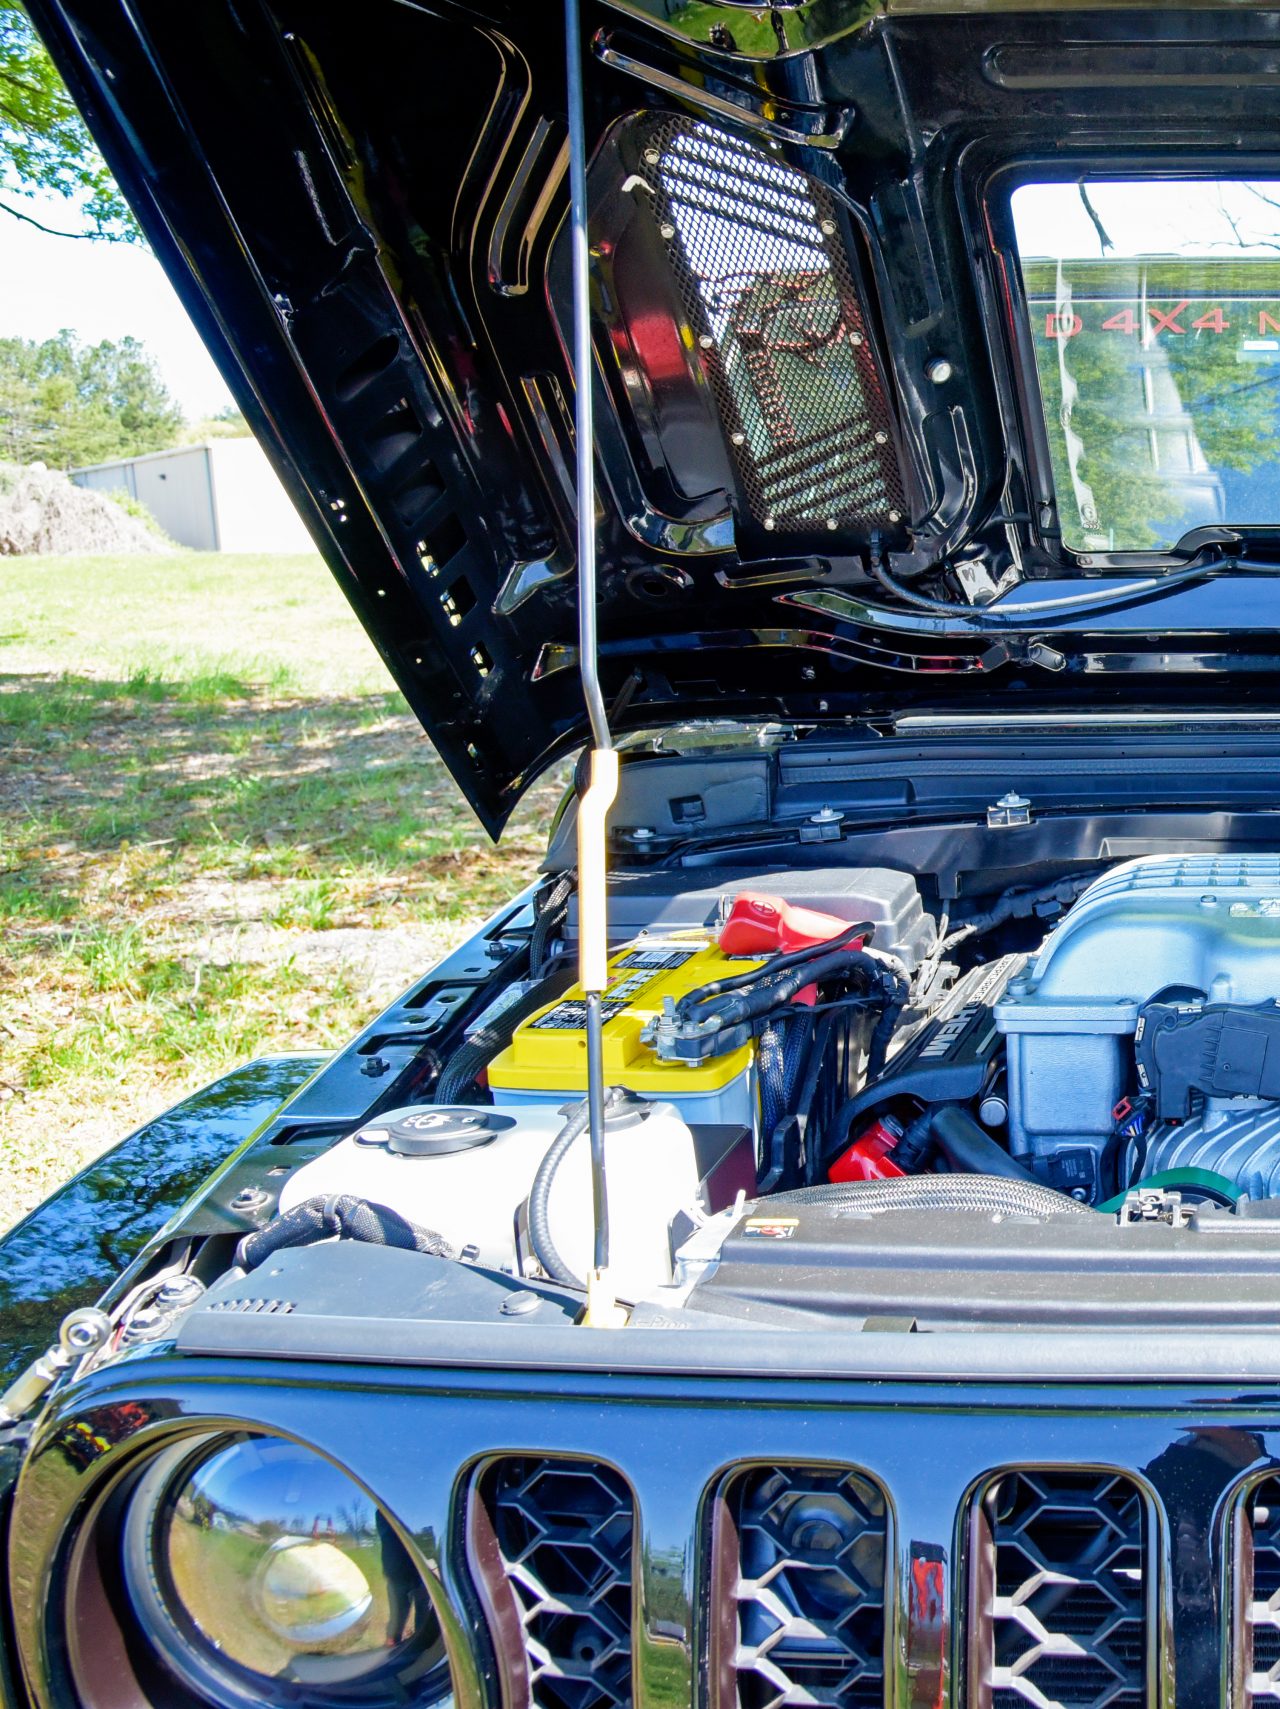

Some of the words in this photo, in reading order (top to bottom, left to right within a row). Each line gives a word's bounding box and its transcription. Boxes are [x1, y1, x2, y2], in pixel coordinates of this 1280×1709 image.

[1045, 312, 1084, 338] D
[1101, 299, 1231, 345] 4X4
[918, 1007, 978, 1058] HEMI
